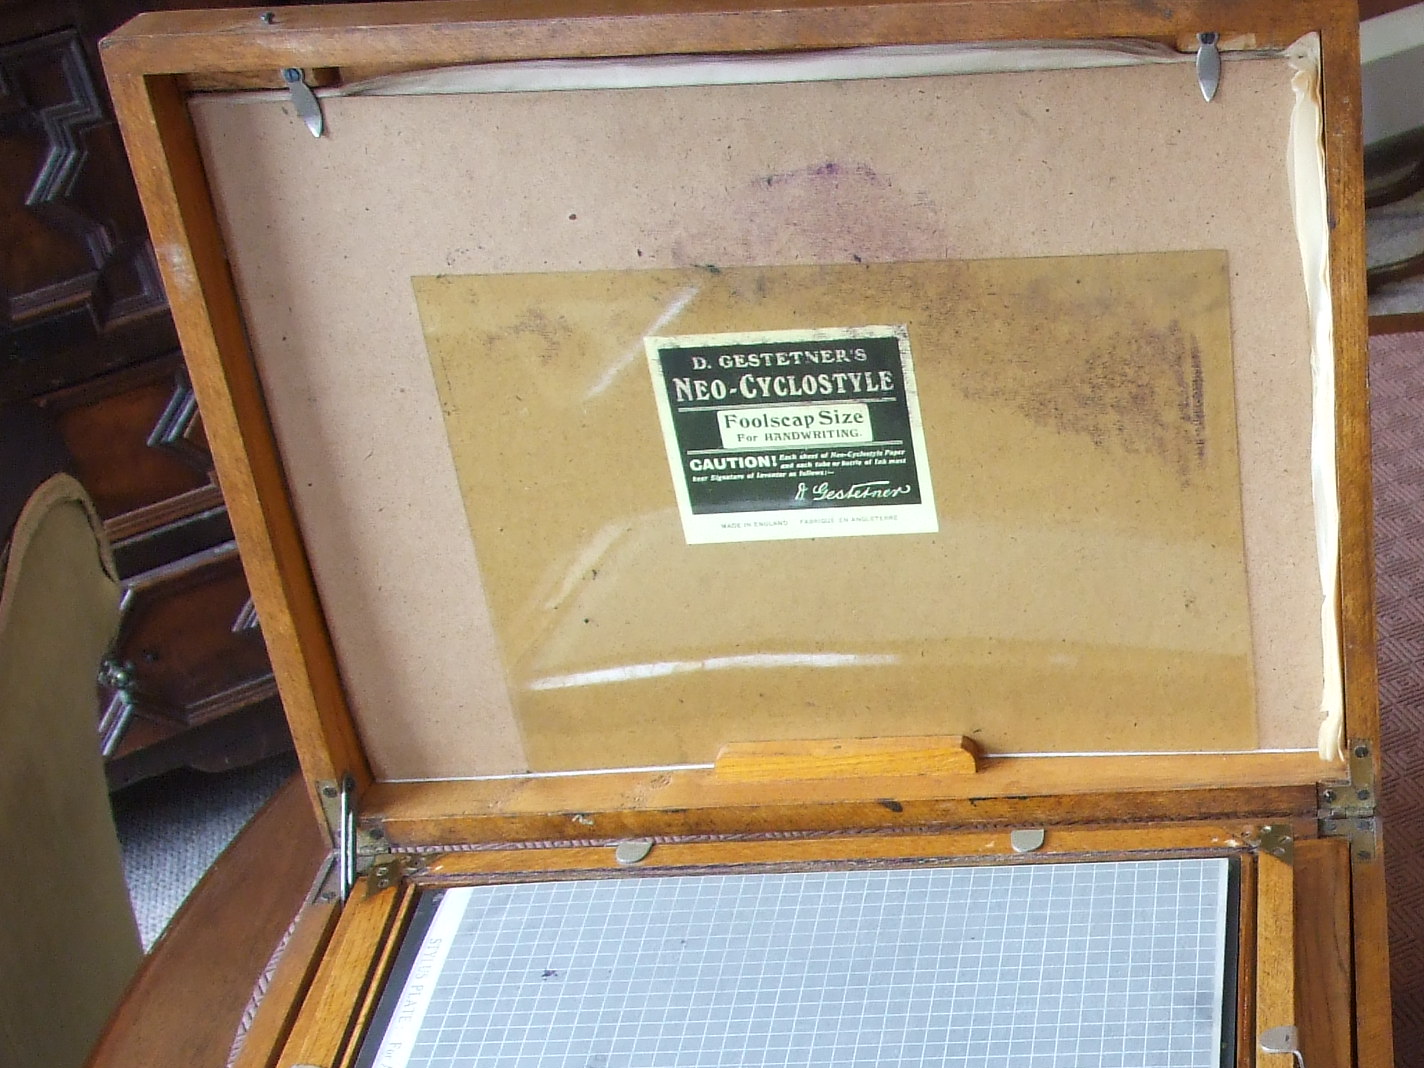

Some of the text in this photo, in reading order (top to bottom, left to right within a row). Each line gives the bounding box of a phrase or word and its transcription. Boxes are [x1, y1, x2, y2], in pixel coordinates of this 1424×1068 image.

[692, 348, 867, 370] D. GESTETNER'S
[672, 370, 895, 402] NEO-CYCLOSTYLE
[725, 408, 865, 429] Foolscap Size
[737, 429, 863, 442] For HANDWRITING.
[884, 449, 906, 458] Paper
[689, 455, 778, 471] CAUTION!
